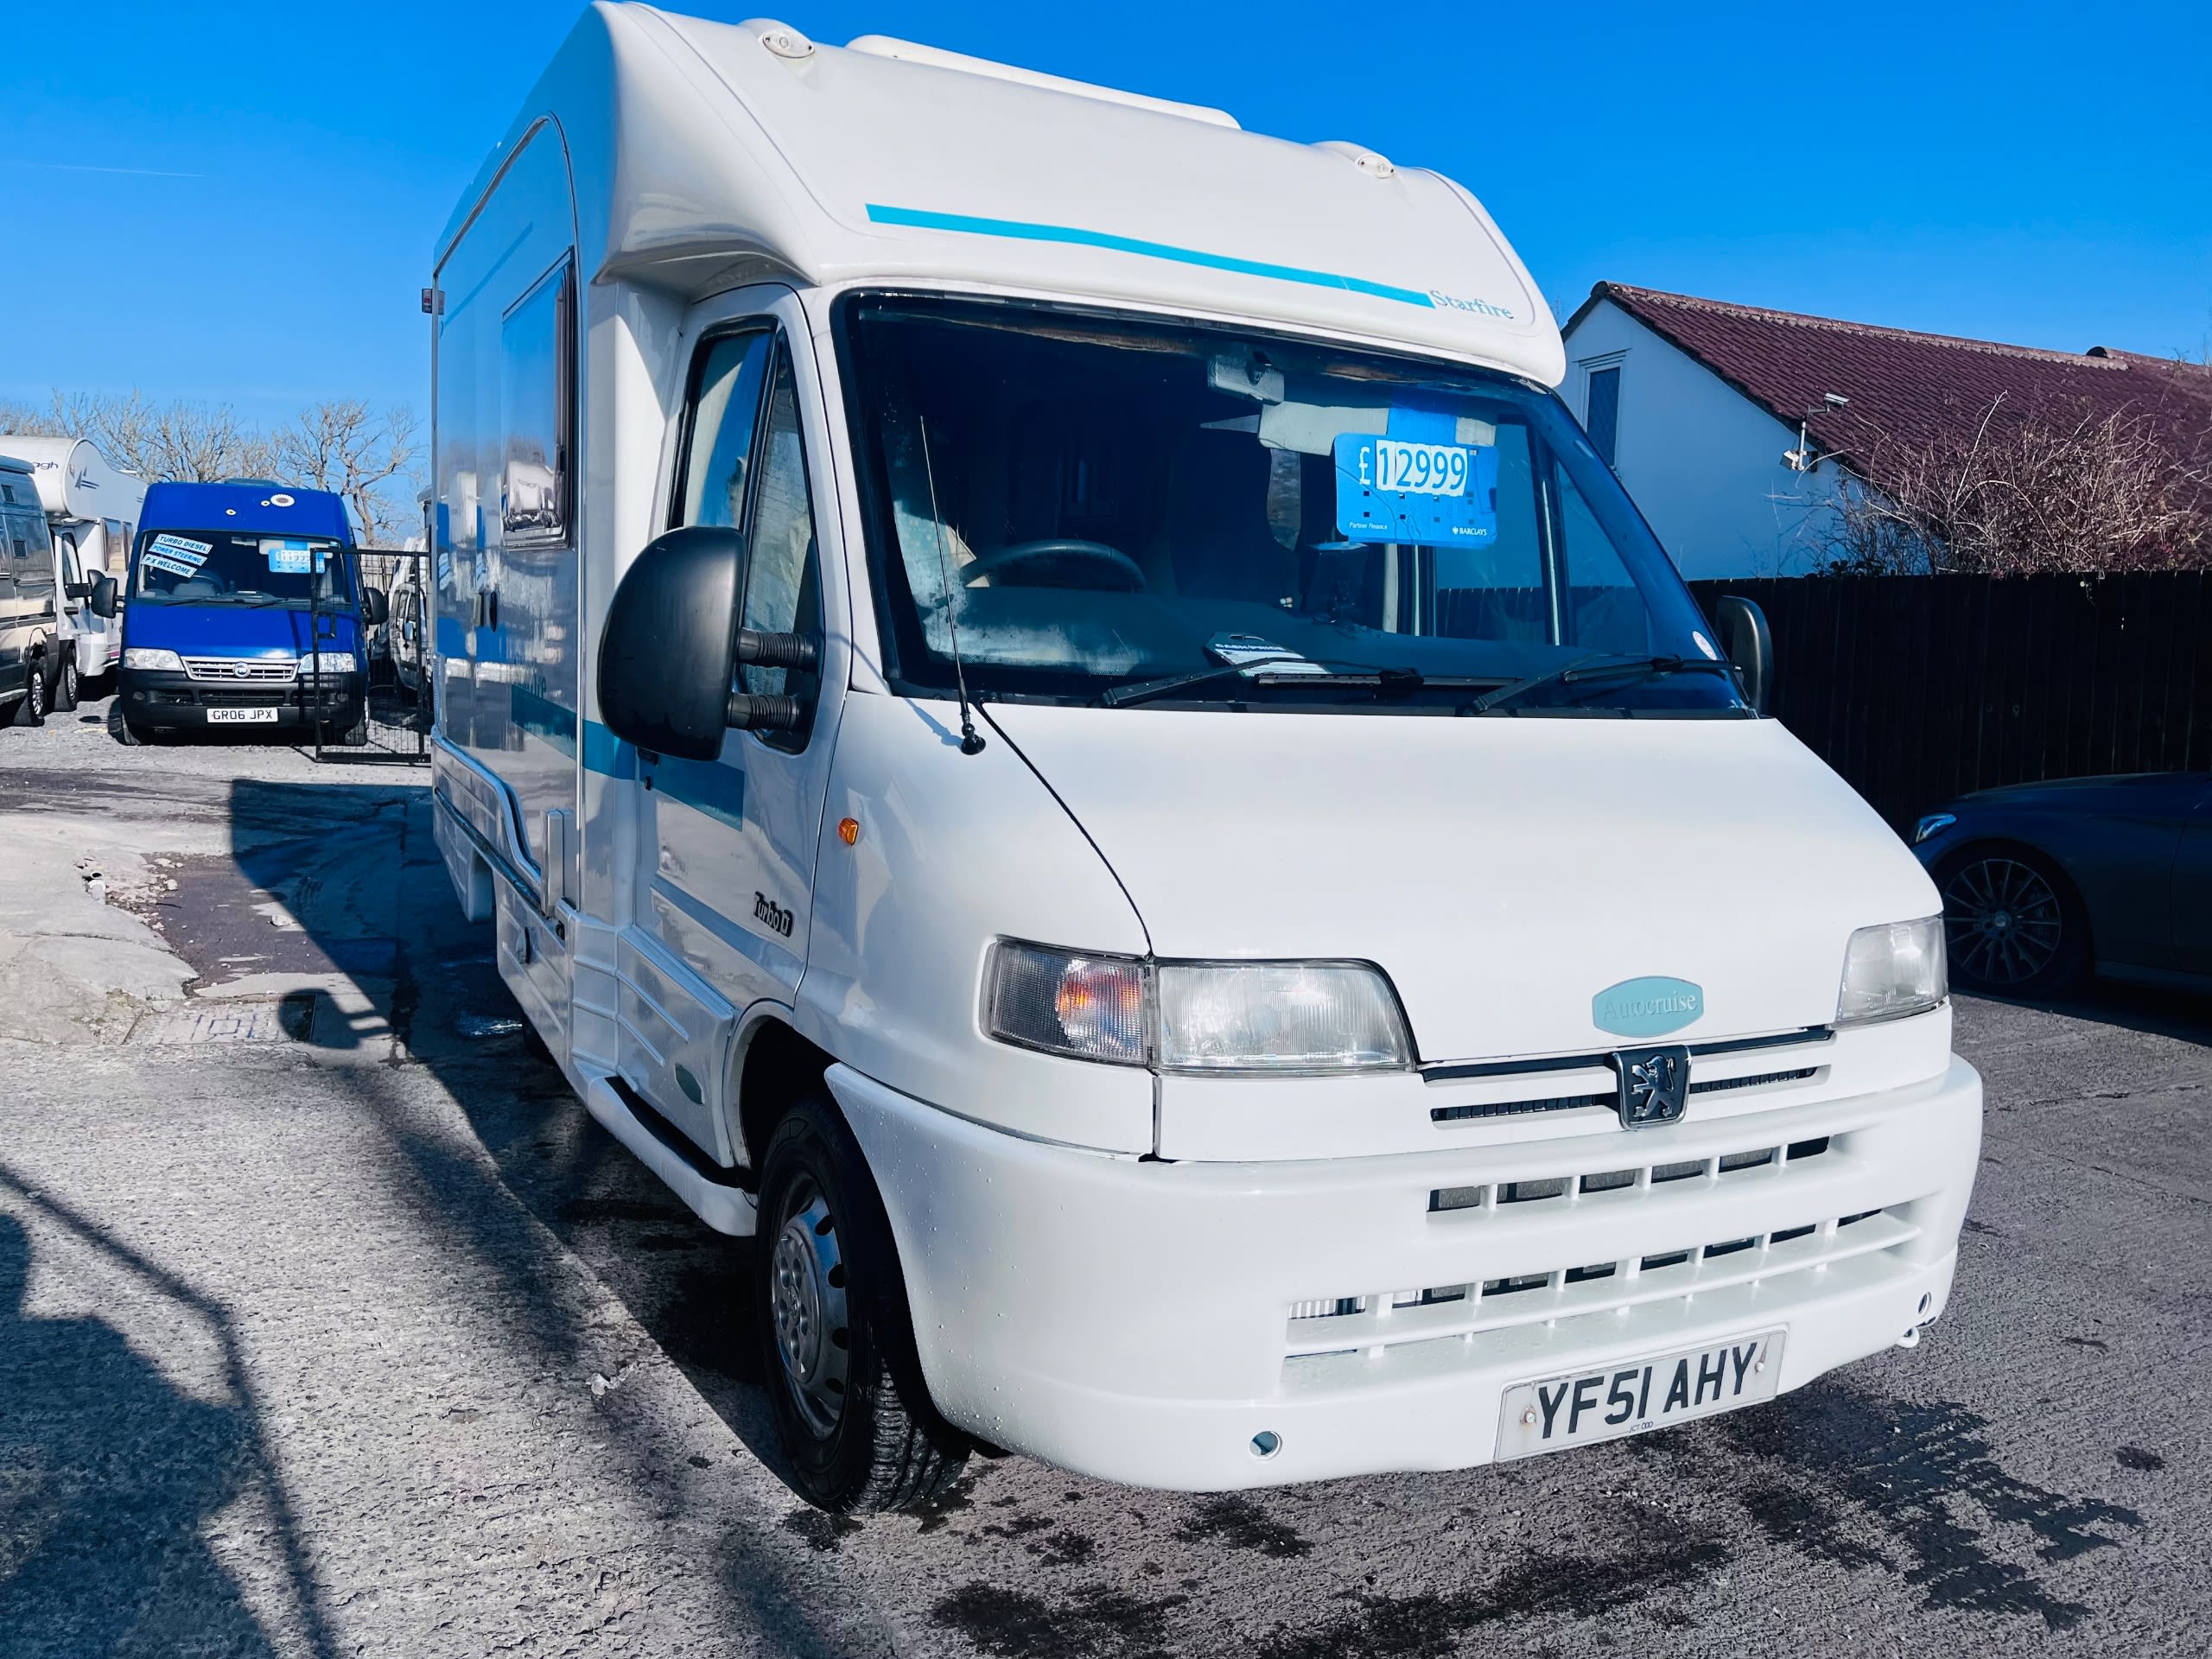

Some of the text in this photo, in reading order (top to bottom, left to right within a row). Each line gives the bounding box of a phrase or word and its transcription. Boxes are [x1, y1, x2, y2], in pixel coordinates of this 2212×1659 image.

[1430, 290, 1514, 319] Starfire
[152, 545, 202, 563] POWER STEERING
[160, 536, 207, 551] TURBO DIESEL
[157, 559, 191, 575] WELCOME
[213, 709, 273, 720] GR06 JPX
[753, 891, 782, 932] Turbo
[1603, 990, 1698, 1020] Autocruise
[1538, 1342, 1758, 1440] YF51 AHY
